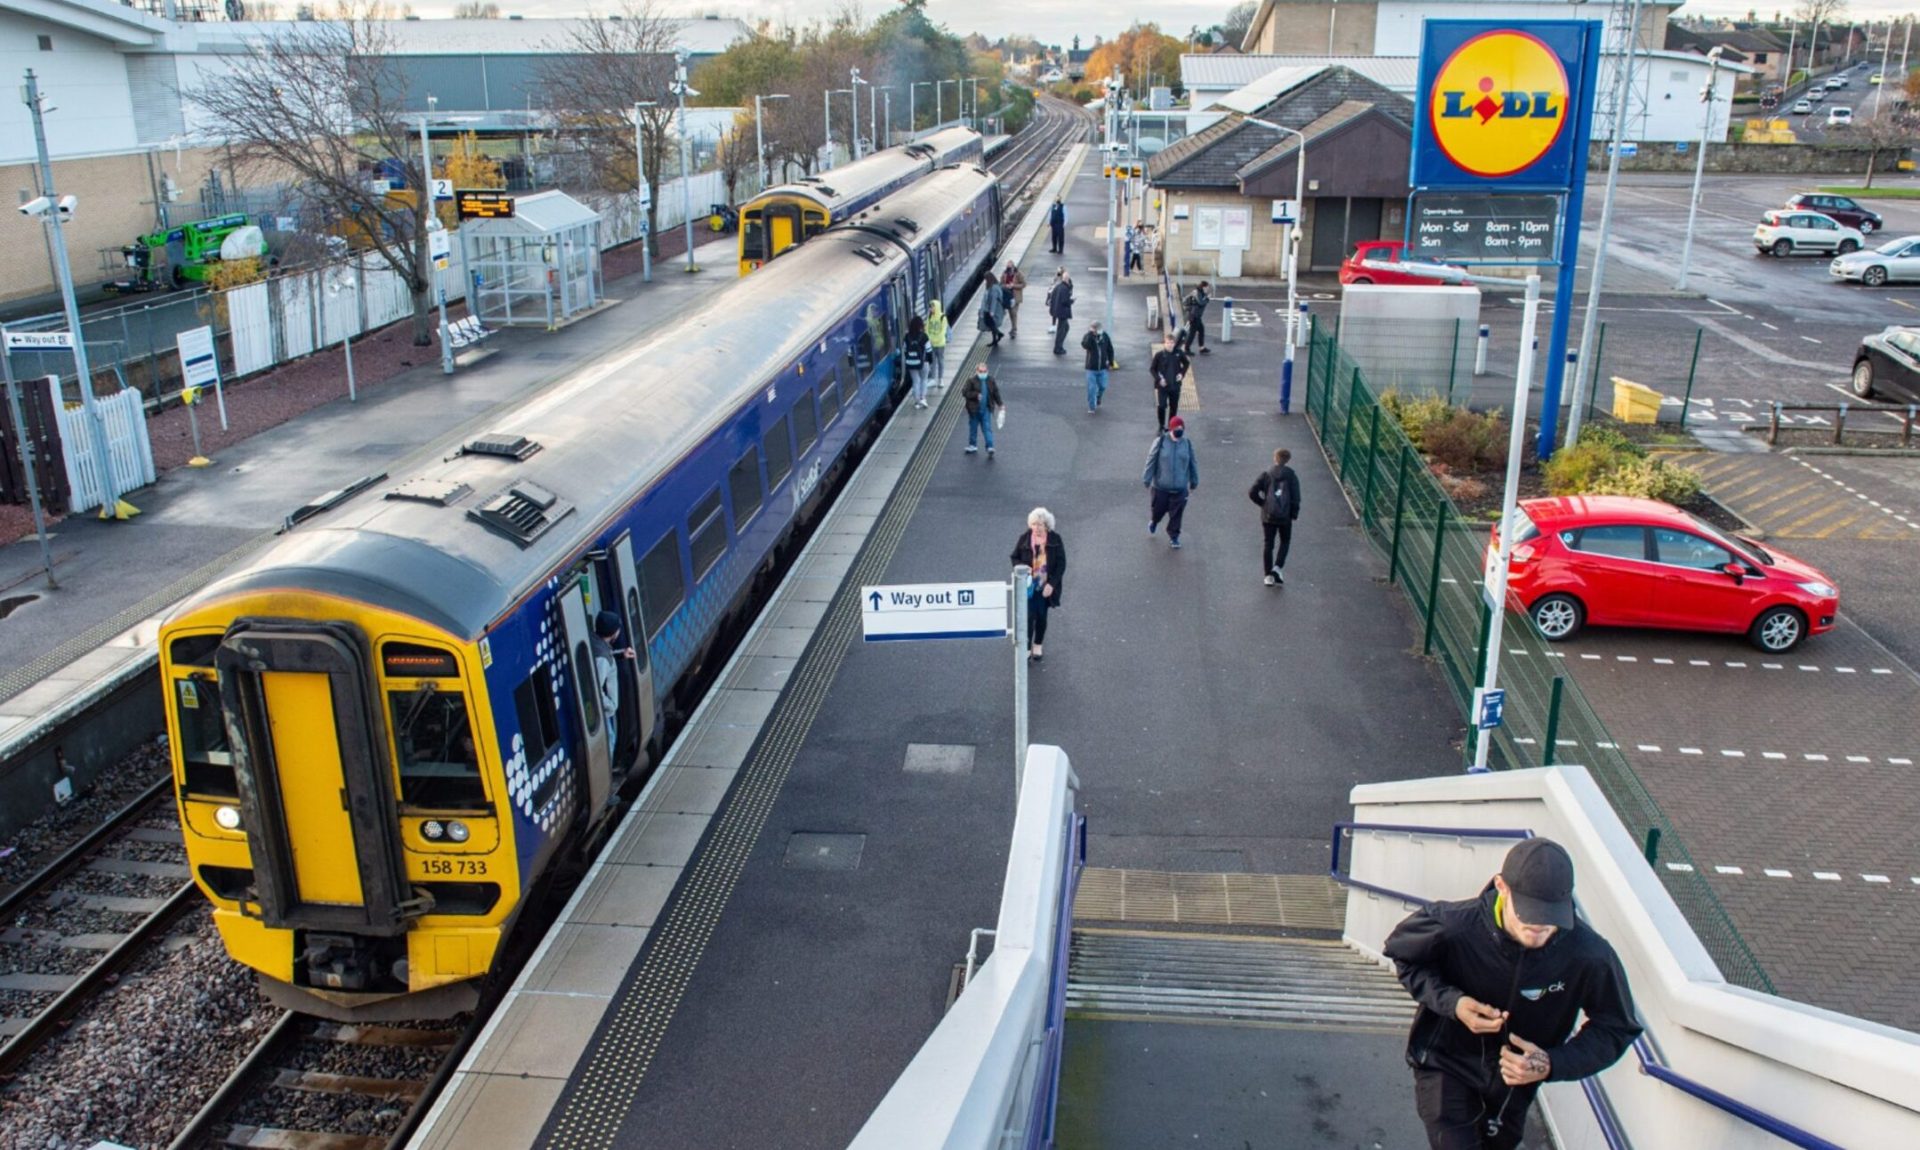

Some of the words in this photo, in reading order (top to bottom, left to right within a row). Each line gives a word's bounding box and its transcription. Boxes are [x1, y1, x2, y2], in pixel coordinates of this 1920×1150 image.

[438, 181, 446, 195] 2
[1279, 202, 1288, 217] 1
[1423, 208, 1446, 216] Opening
[1420, 222, 1443, 232] Mon
[1453, 221, 1469, 232] Sat
[1486, 221, 1509, 232] 8am
[1520, 221, 1549, 234] 10pm
[1421, 236, 1441, 247] Sun
[1485, 235, 1508, 246] 8am
[1518, 235, 1541, 248] 9pm
[24, 335, 40, 345] Way
[42, 335, 56, 344] out
[891, 592, 922, 607] Way
[926, 591, 952, 604] out
[422, 860, 452, 874] 158
[457, 861, 487, 875] 733
